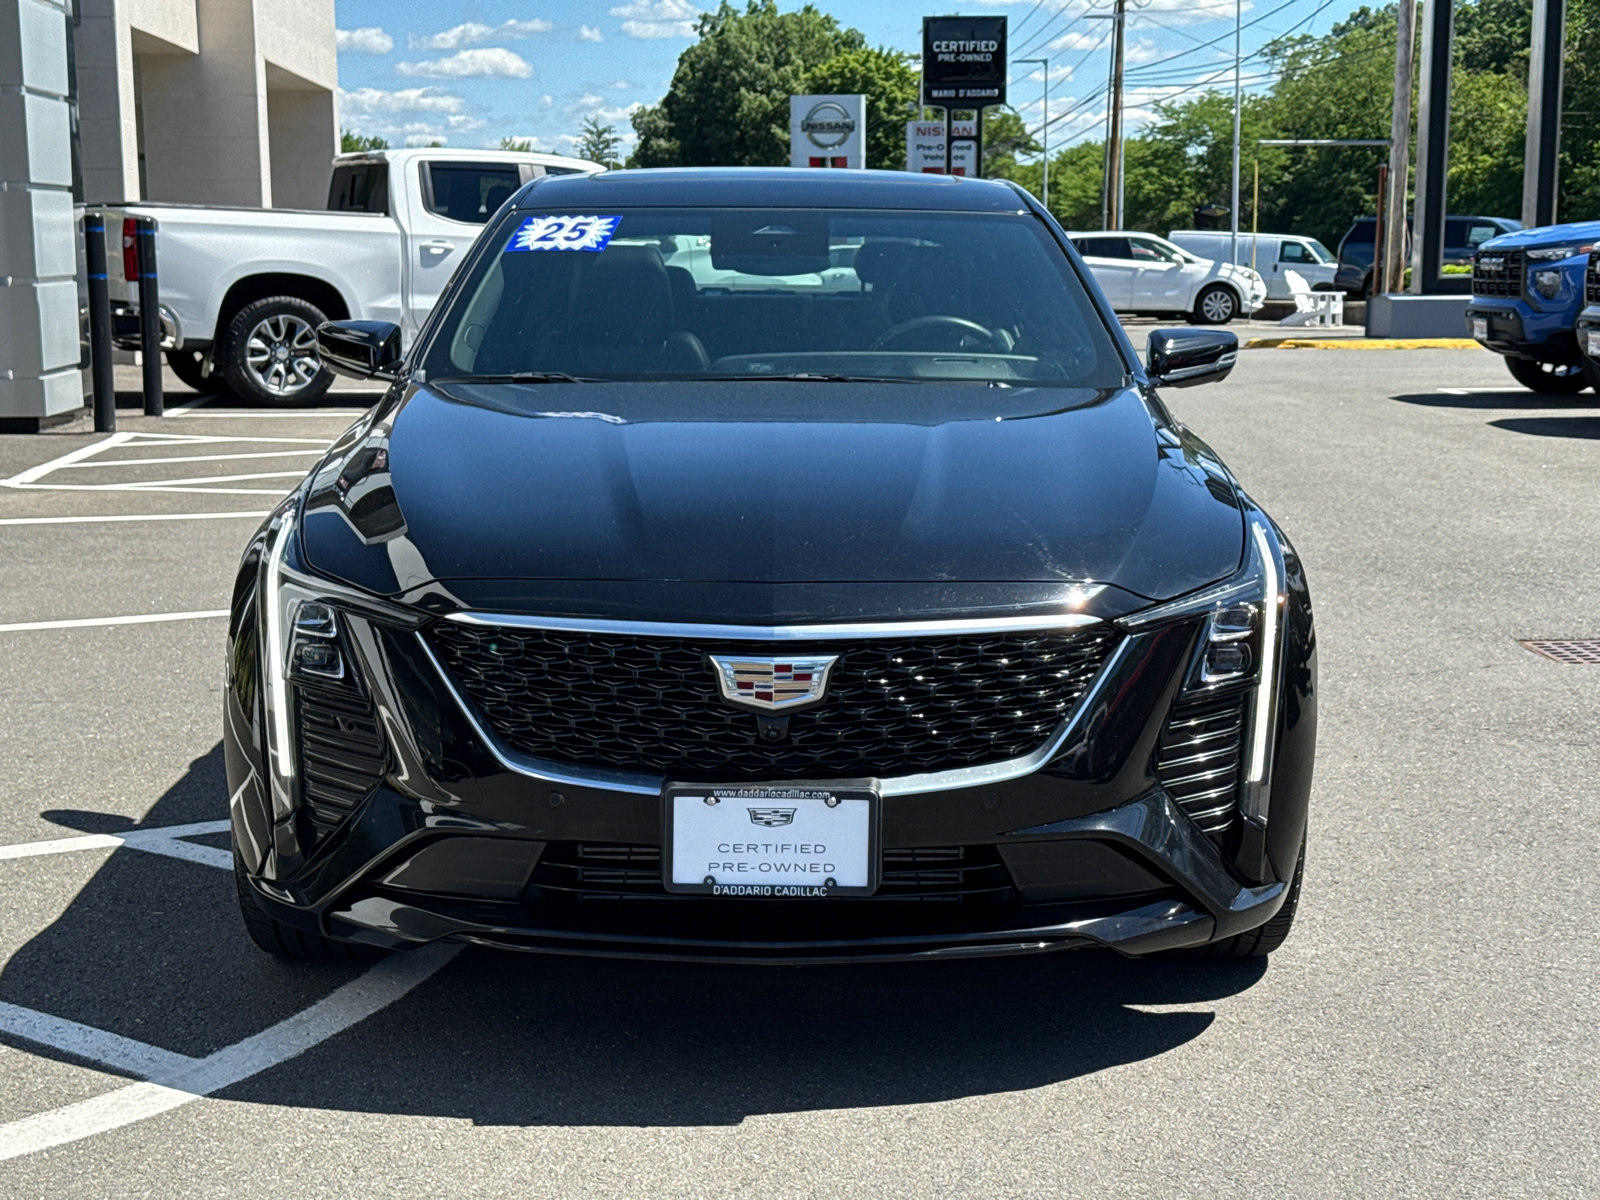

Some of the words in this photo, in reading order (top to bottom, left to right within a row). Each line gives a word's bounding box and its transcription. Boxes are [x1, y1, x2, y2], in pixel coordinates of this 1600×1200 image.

[932, 40, 998, 52] CERTIFIED
[938, 53, 993, 62] PRE-OWNED
[932, 89, 956, 97] MARIO
[806, 122, 850, 130] NISSAN
[916, 127, 972, 136] NISAN
[916, 143, 972, 151] Pre-Oned
[534, 222, 593, 242] 25
[713, 788, 831, 799] www.daddariocadillac.com
[717, 843, 826, 854] CERTIFIED
[708, 862, 836, 872] PRE-OWNED
[713, 885, 771, 896] D'ADDARIO
[774, 886, 827, 897] CADILLAC
